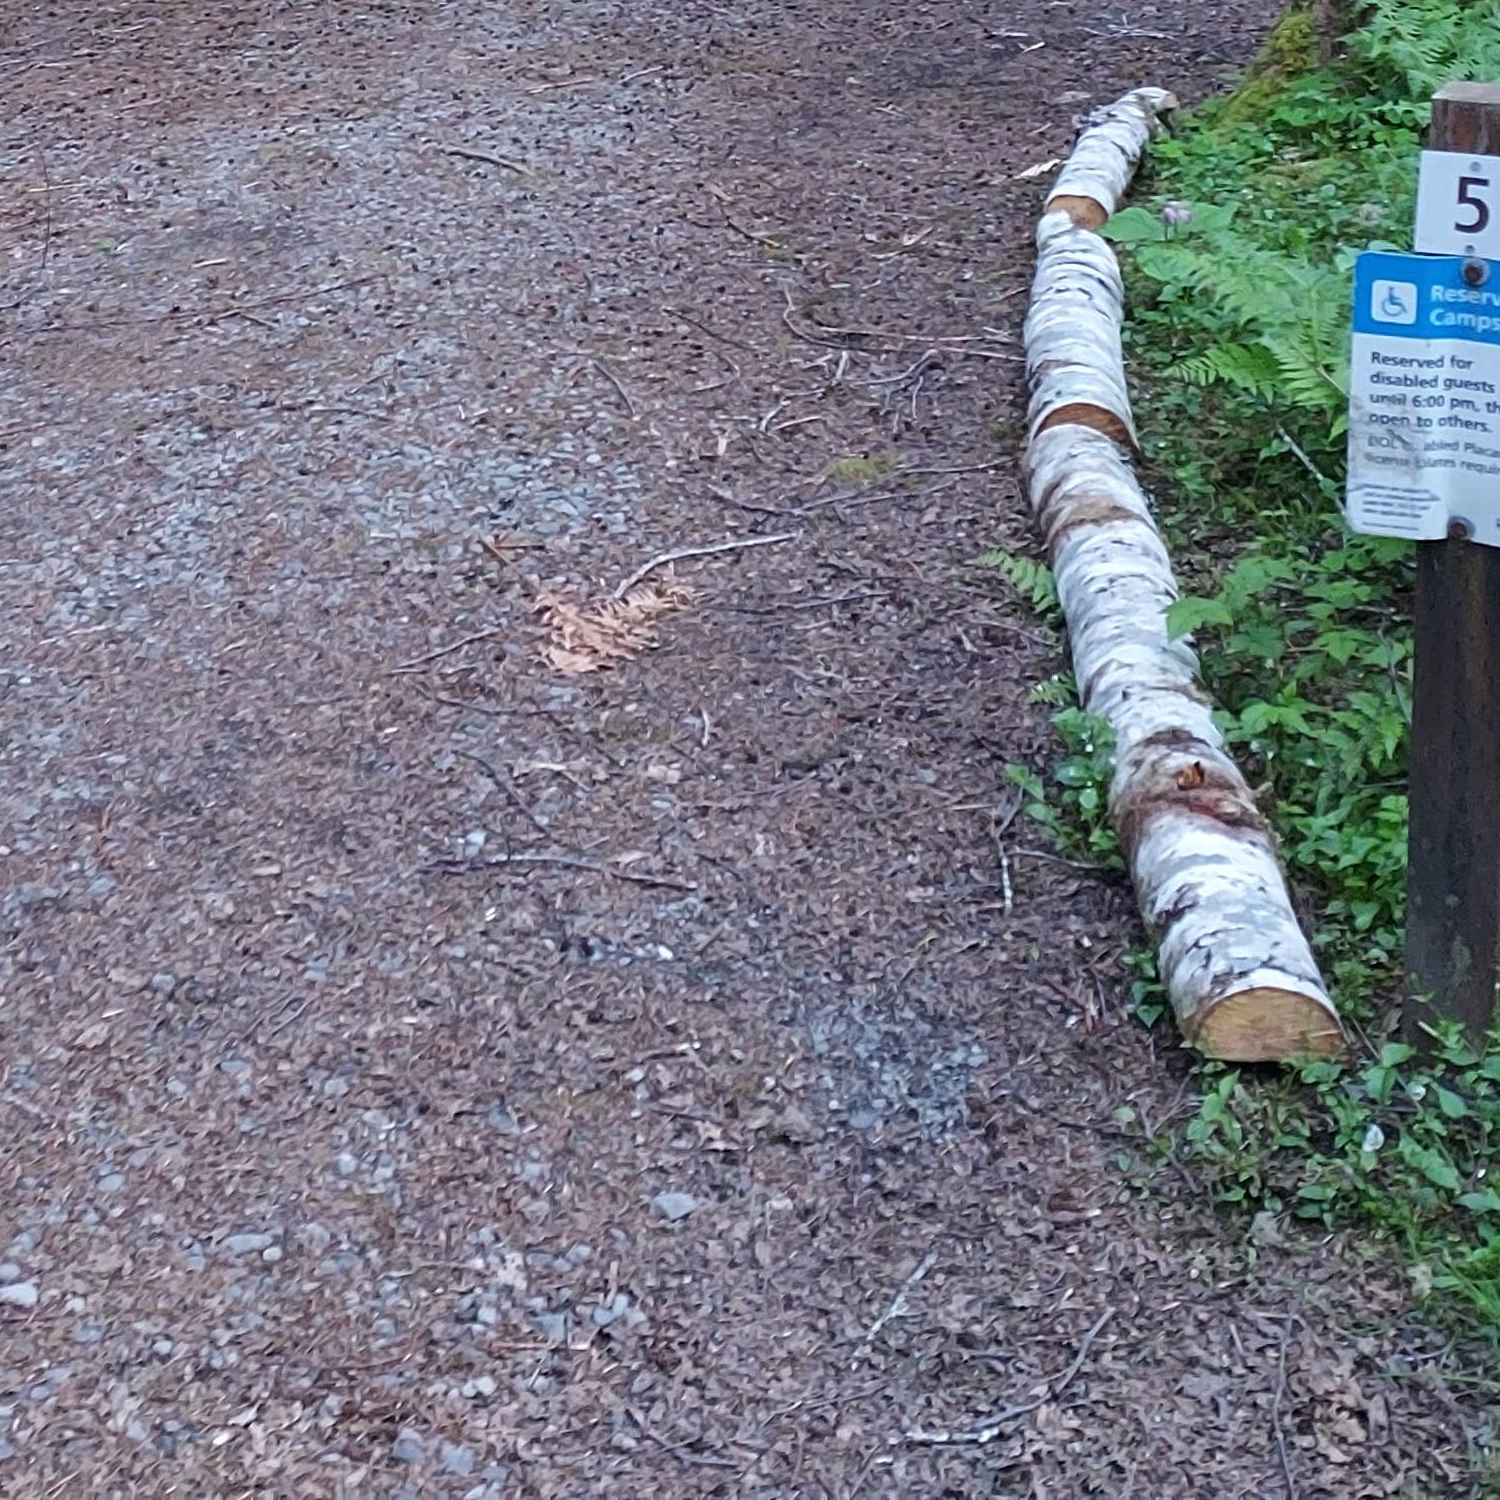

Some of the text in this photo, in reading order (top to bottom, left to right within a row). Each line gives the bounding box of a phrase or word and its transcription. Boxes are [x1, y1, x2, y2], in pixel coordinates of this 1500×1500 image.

[1454, 176, 1490, 234] 5
[1371, 351, 1474, 369] Reserved for
[1369, 372, 1496, 394] disabled guests
[1369, 393, 1407, 406] until
[1412, 395, 1445, 408] 6:00
[1368, 413, 1493, 433] open to others.
